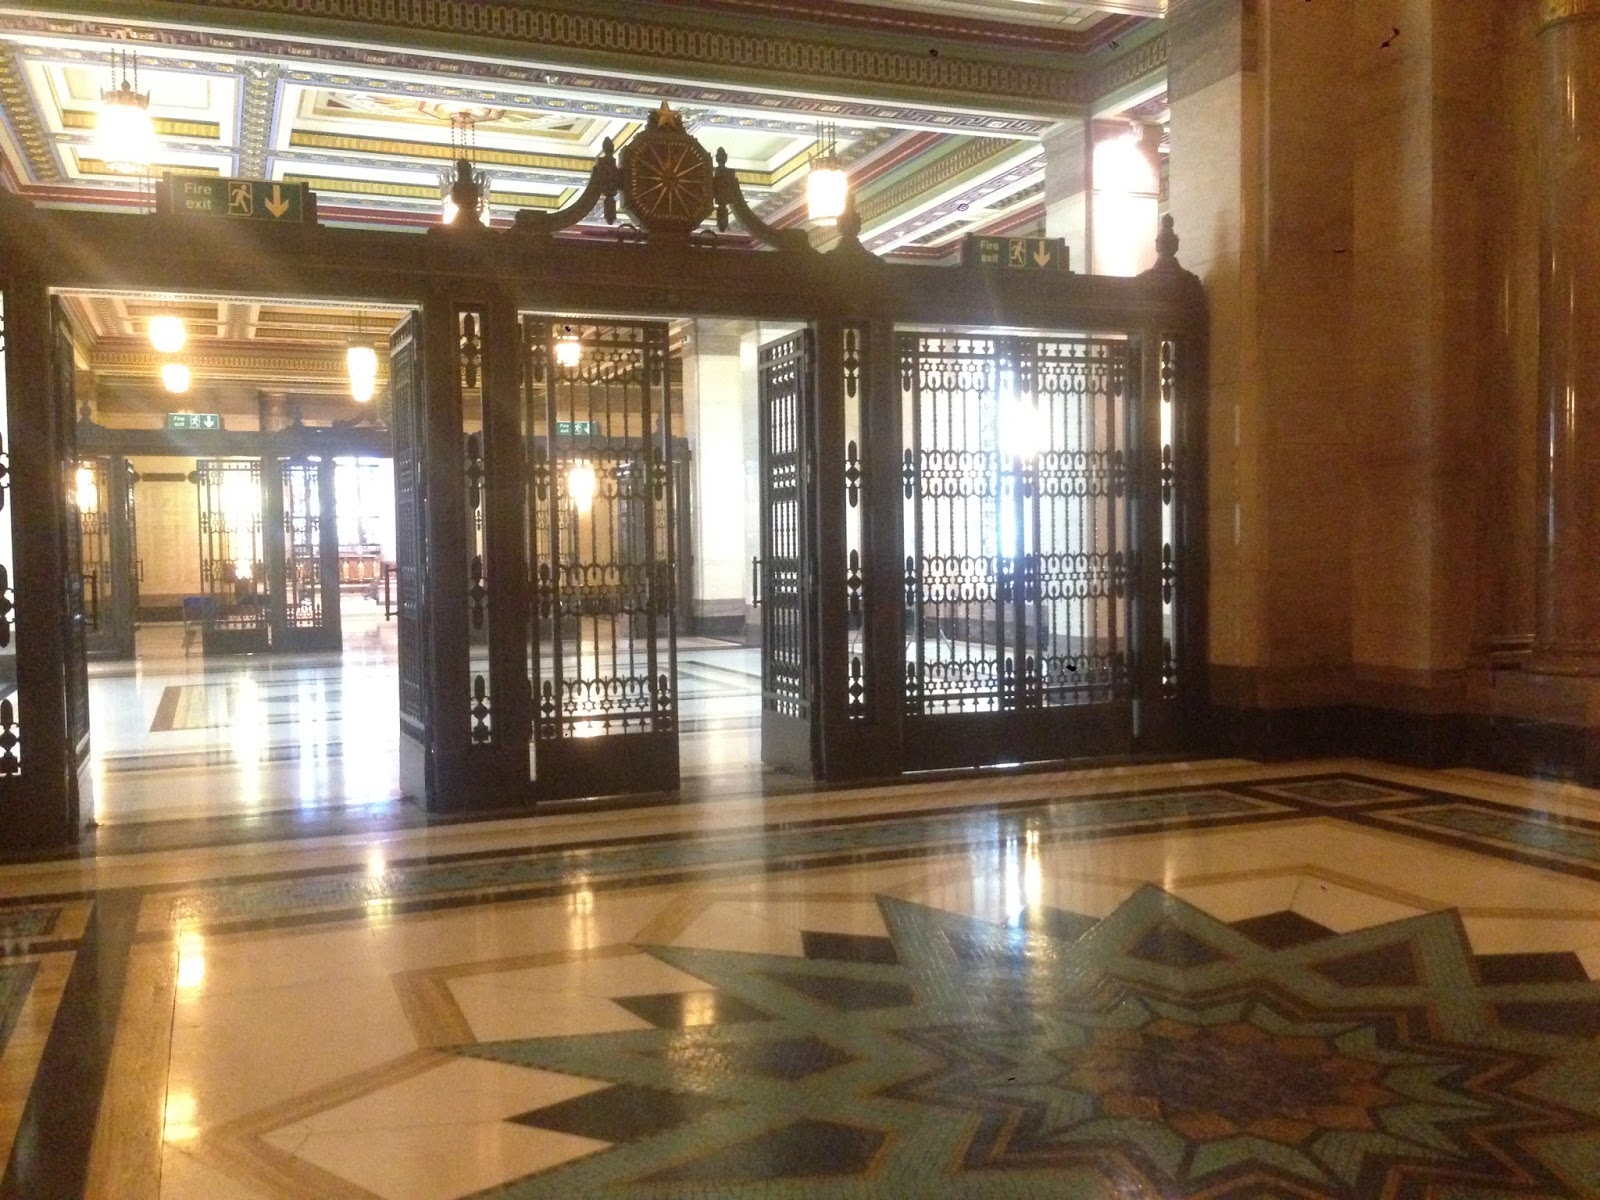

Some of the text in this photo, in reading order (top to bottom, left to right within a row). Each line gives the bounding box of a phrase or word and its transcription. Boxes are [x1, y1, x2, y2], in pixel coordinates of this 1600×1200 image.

[184, 182, 212, 195] Fire
[185, 199, 212, 210] exit
[980, 240, 999, 251] Fire
